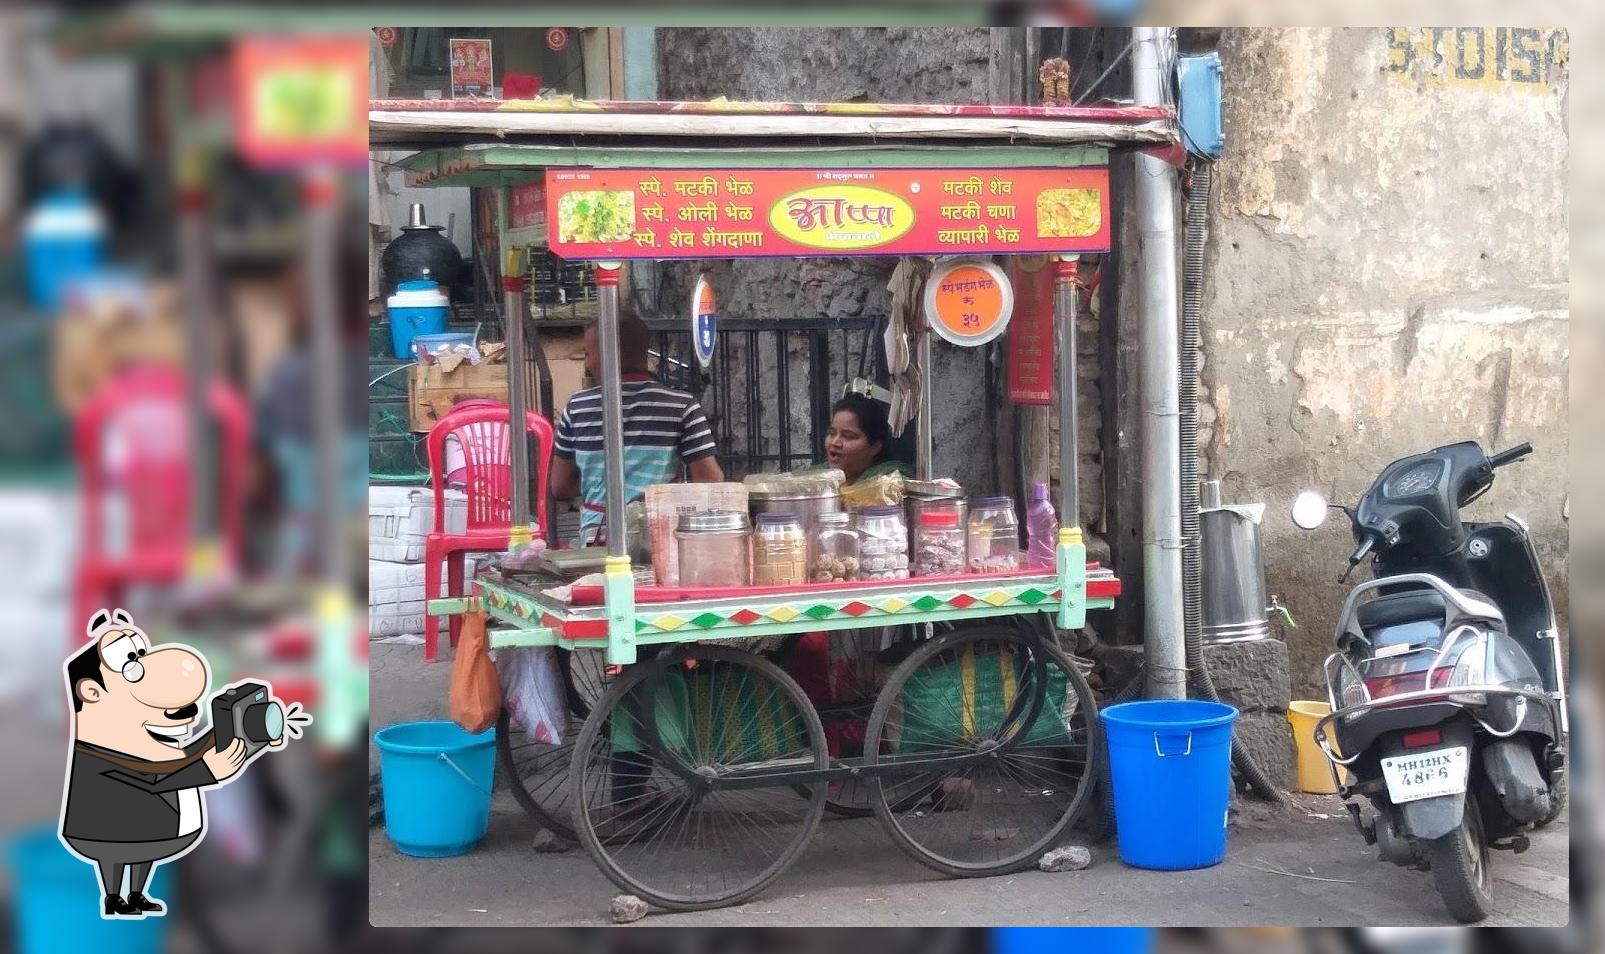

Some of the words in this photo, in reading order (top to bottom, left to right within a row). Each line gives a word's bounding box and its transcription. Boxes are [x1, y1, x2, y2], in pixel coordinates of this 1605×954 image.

[638, 176, 667, 197] स्पे.
[674, 175, 719, 197] मटकी
[725, 176, 754, 197] भेळ
[943, 176, 983, 196] मटकी
[989, 175, 1013, 196] शेव
[641, 202, 670, 223] स्पे.
[677, 201, 718, 222] ओली
[725, 202, 754, 222] भेळ
[940, 200, 981, 220] मटकी
[986, 205, 1017, 220] चणा
[633, 228, 662, 248] स्पे.
[669, 228, 696, 248] शेव
[701, 227, 763, 249] शेंगदाणा
[937, 224, 989, 244] व्यापारी
[994, 225, 1021, 244] भेळ
[1397, 755, 1452, 771] MH12HX
